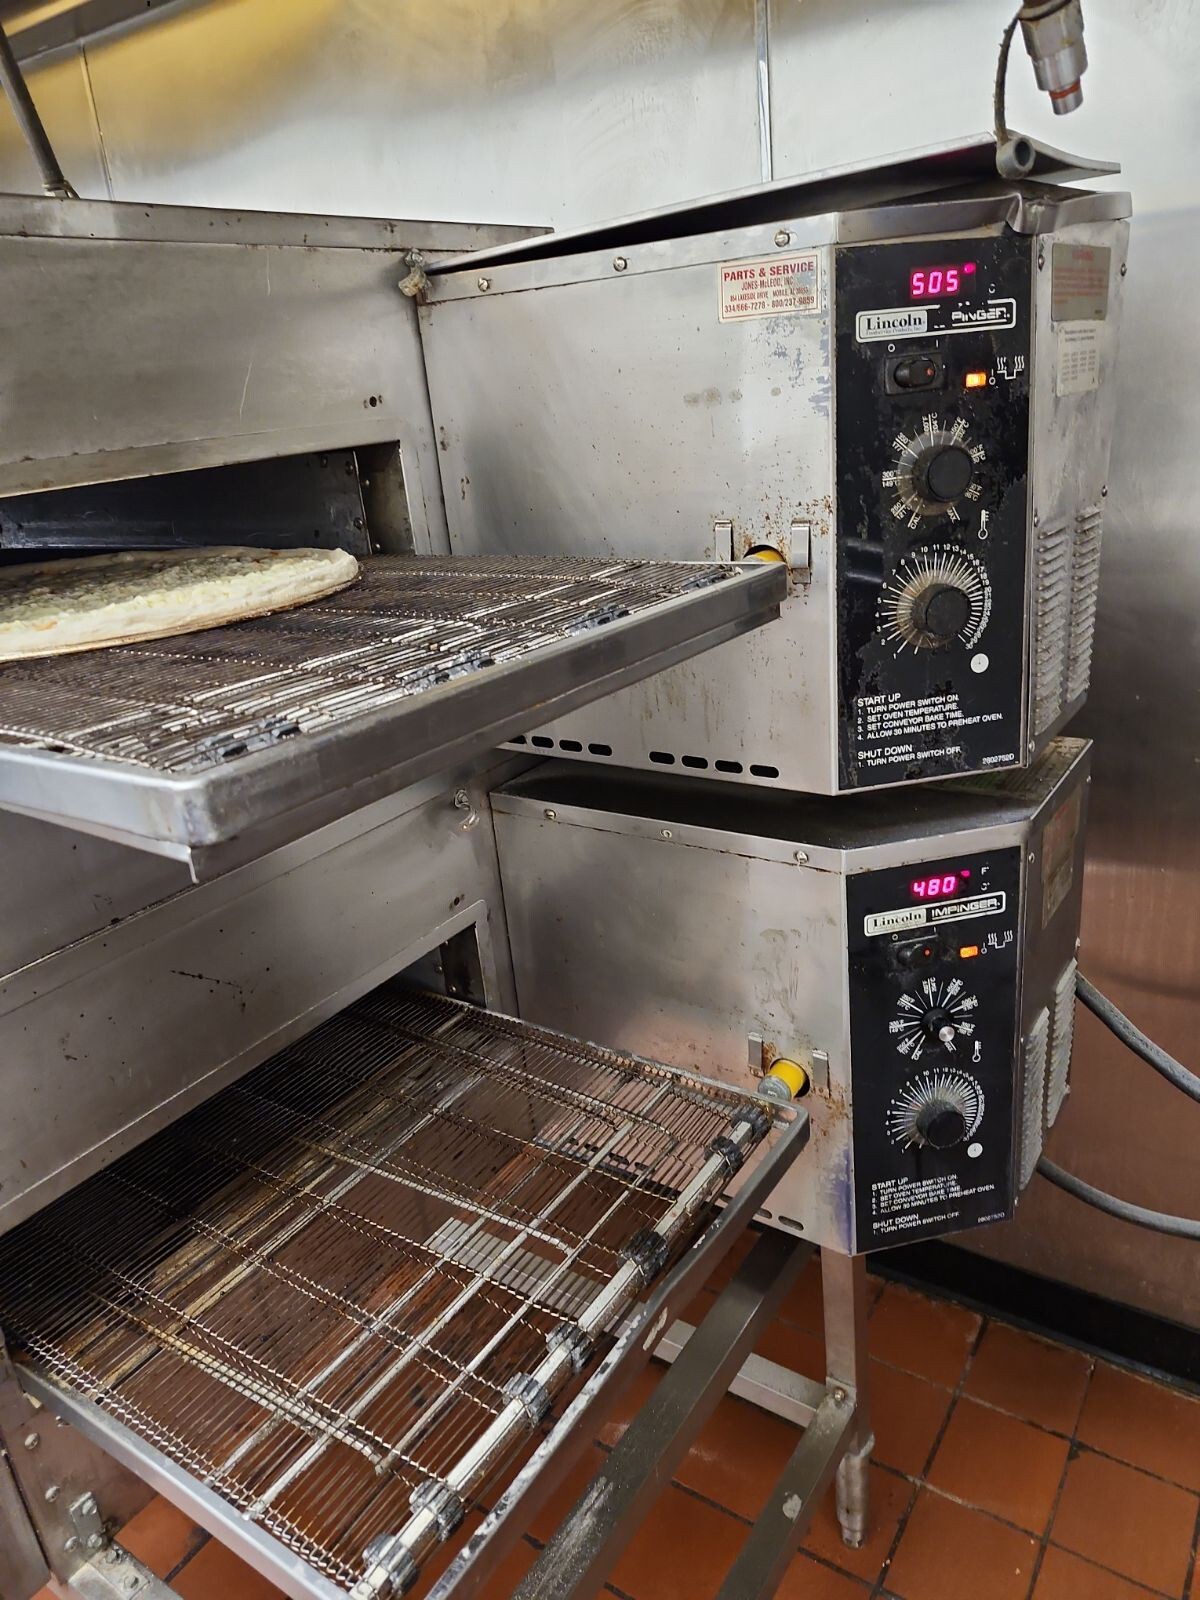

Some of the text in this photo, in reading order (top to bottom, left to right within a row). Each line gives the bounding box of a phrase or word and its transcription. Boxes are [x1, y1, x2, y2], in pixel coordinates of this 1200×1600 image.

[724, 262, 814, 281] PARTS & SERVICE
[913, 270, 958, 295] 505
[867, 314, 922, 330] Lincoln
[857, 693, 901, 708] START UP
[866, 705, 887, 715] TURN
[888, 700, 916, 711] POWER
[917, 695, 945, 707] SWITCH
[866, 714, 881, 723] SET
[883, 710, 903, 720] OVEN
[904, 703, 959, 717] TEMPERATURE.
[866, 723, 881, 732] SET
[883, 717, 923, 729] CONVEYOR
[925, 713, 944, 722] BAKE
[945, 710, 964, 719] TIME.
[866, 730, 893, 740] ALLOW
[903, 723, 936, 734] MINUTES
[948, 716, 981, 728] PREHEAT
[982, 713, 1003, 722] OVEN.
[857, 744, 912, 760] SHUT DOWN
[866, 758, 887, 767] TURN
[888, 753, 915, 764] POWER
[916, 748, 945, 760] SWITCH
[913, 876, 956, 897] 480
[873, 912, 922, 928] Lincoln
[872, 1177, 909, 1191] START UP
[880, 1186, 897, 1194] TURN
[898, 1181, 921, 1190] POWER
[922, 1177, 946, 1186] SWITCH
[880, 1204, 901, 1214] ALLOW
[910, 1197, 938, 1208] MINUTES
[948, 1188, 976, 1198] PREHEAT
[893, 1190, 911, 1198] OVEN
[894, 1193, 928, 1205] CONVEYOR
[928, 1189, 945, 1198] BAKE
[872, 1213, 919, 1229] SHUT DOWN
[880, 1225, 897, 1234] TURN
[898, 1220, 922, 1229] POWER
[922, 1215, 946, 1225] SWITCH
